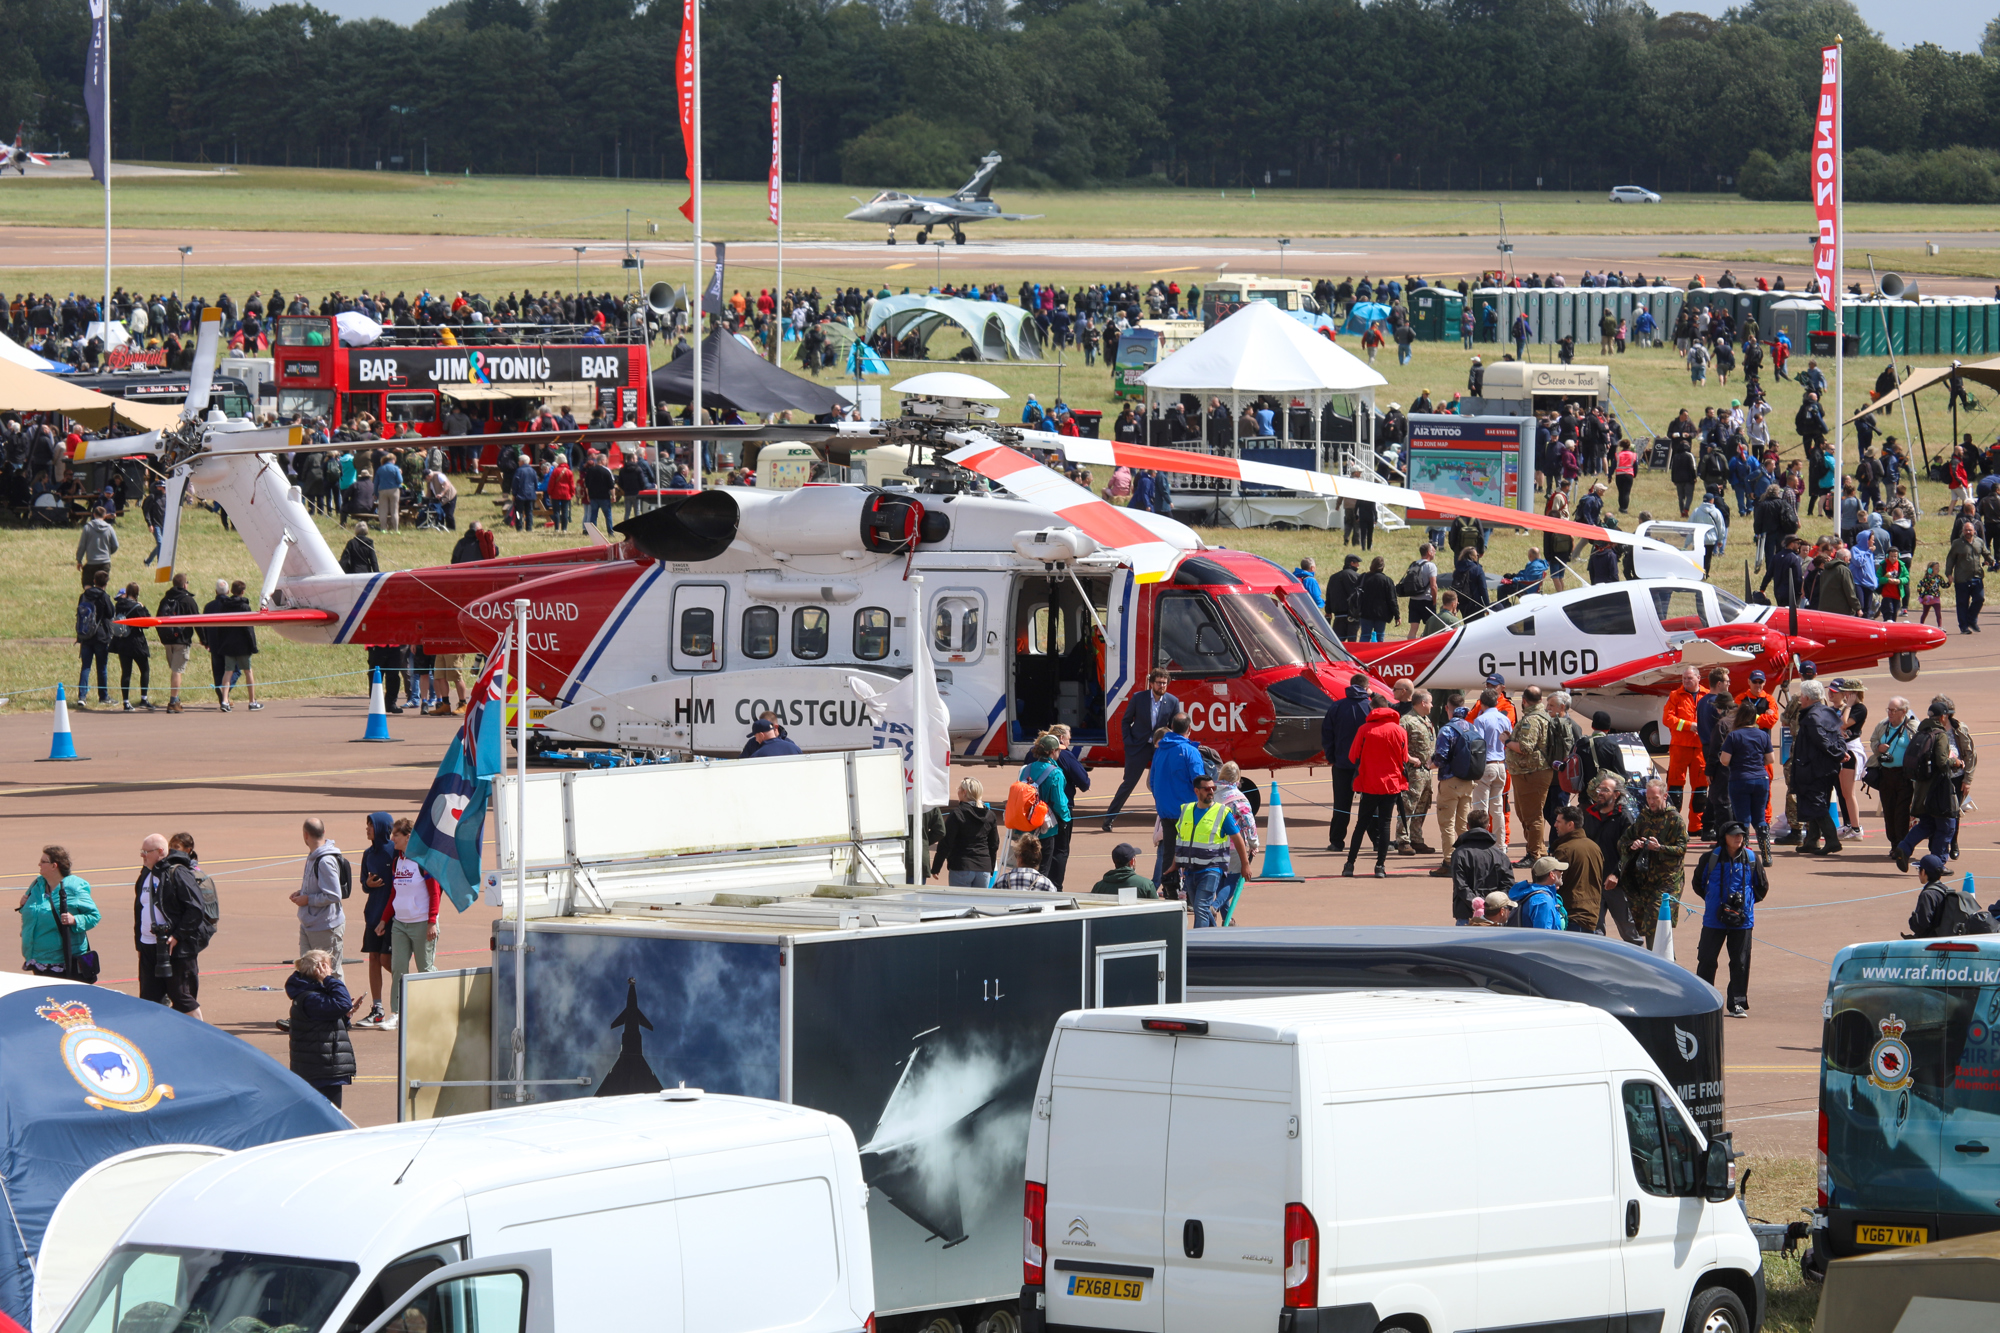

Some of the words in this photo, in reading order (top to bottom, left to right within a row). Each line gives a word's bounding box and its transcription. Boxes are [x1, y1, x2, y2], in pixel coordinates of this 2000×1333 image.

[359, 358, 398, 382] BAR
[581, 356, 619, 379] BAR
[1537, 372, 1566, 386] Cheese
[1573, 372, 1595, 386] Toast
[1413, 428, 1430, 436] AIR
[1430, 428, 1462, 437] TATTOO
[787, 448, 812, 456] ICE
[1478, 648, 1599, 678] G-HMGD
[674, 698, 715, 725] HM
[734, 699, 873, 727] COASTGUA
[1179, 701, 1249, 733] CGK
[1954, 1065, 1989, 1078] Battle
[1862, 1227, 1893, 1242] YG67
[1897, 1229, 1921, 1244] VWA
[1075, 1278, 1111, 1296] FX68
[1113, 1281, 1141, 1299] LSD
